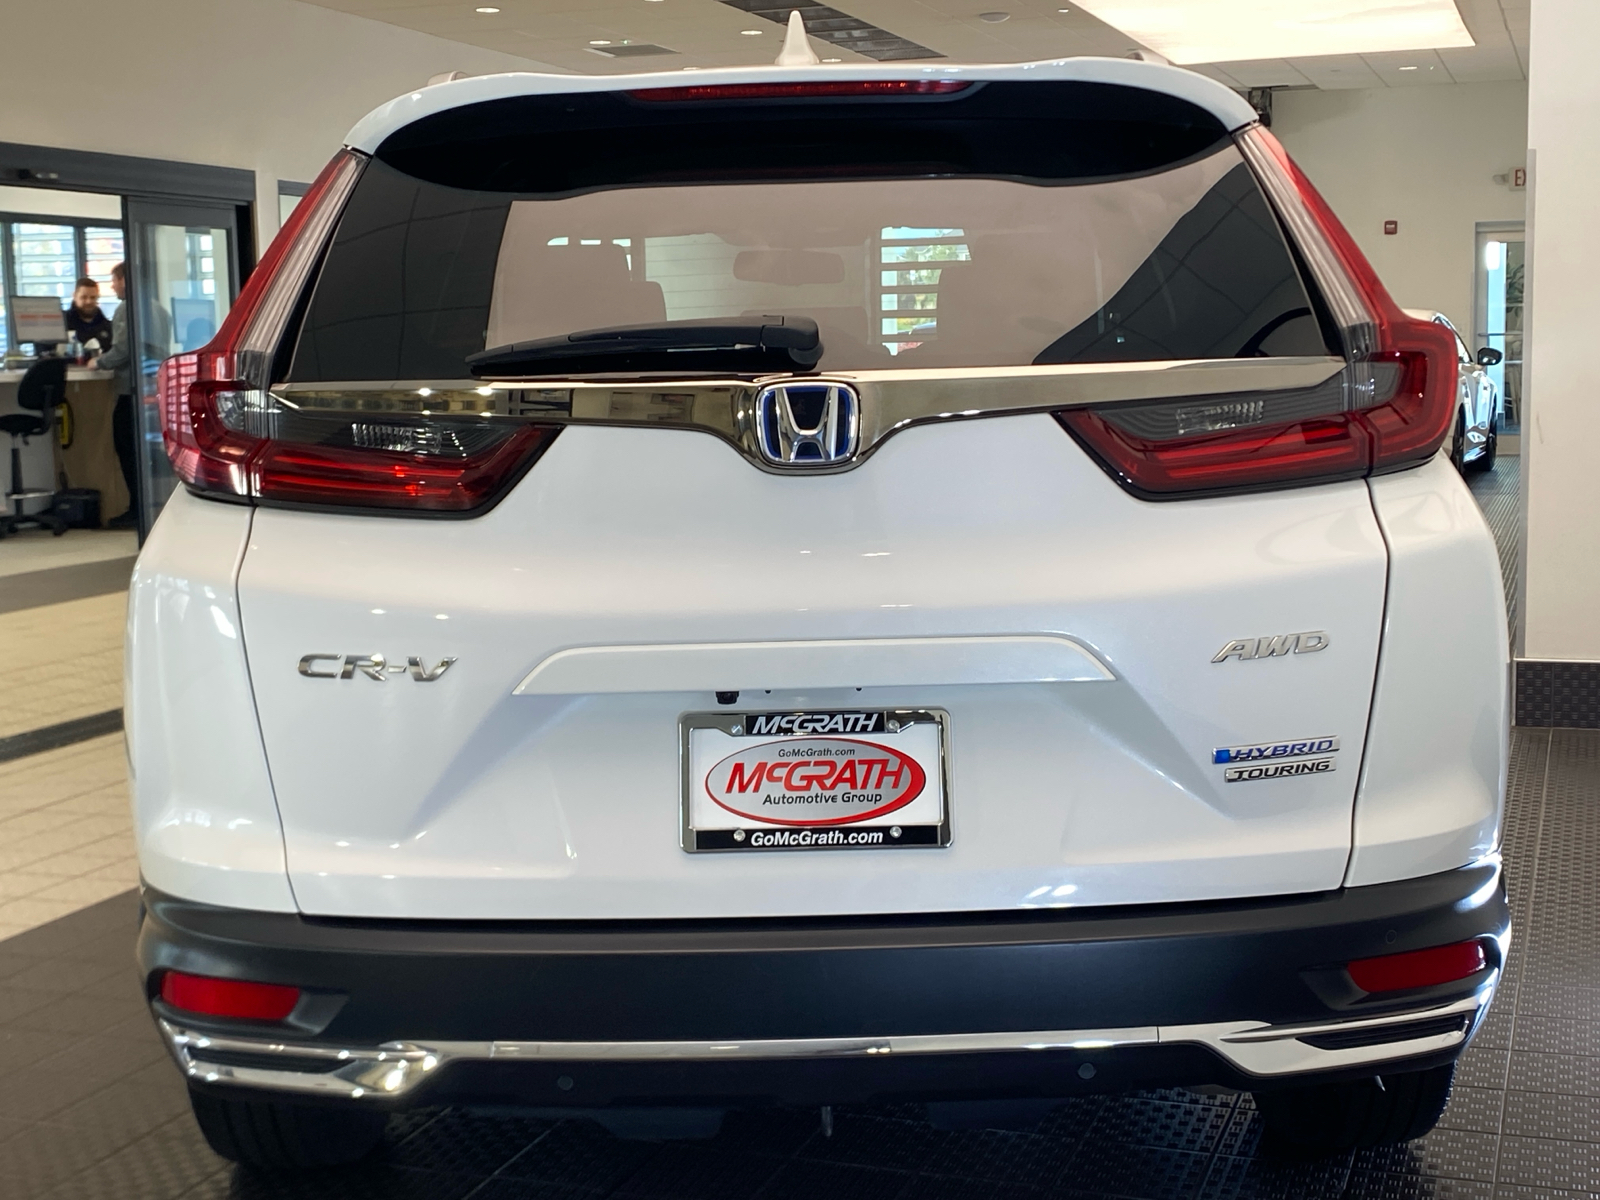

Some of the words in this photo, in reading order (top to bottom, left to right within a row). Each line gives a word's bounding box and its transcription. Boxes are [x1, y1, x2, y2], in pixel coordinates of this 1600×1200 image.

[1211, 630, 1330, 663] AWD
[297, 652, 458, 682] CR-V
[778, 747, 855, 758] GoMcGrath.com
[1230, 739, 1333, 760] HYBRID
[1233, 760, 1331, 780] TOURING
[763, 793, 838, 805] Automotive
[841, 792, 882, 804] Group
[751, 832, 883, 847] GoMcGrath.com
